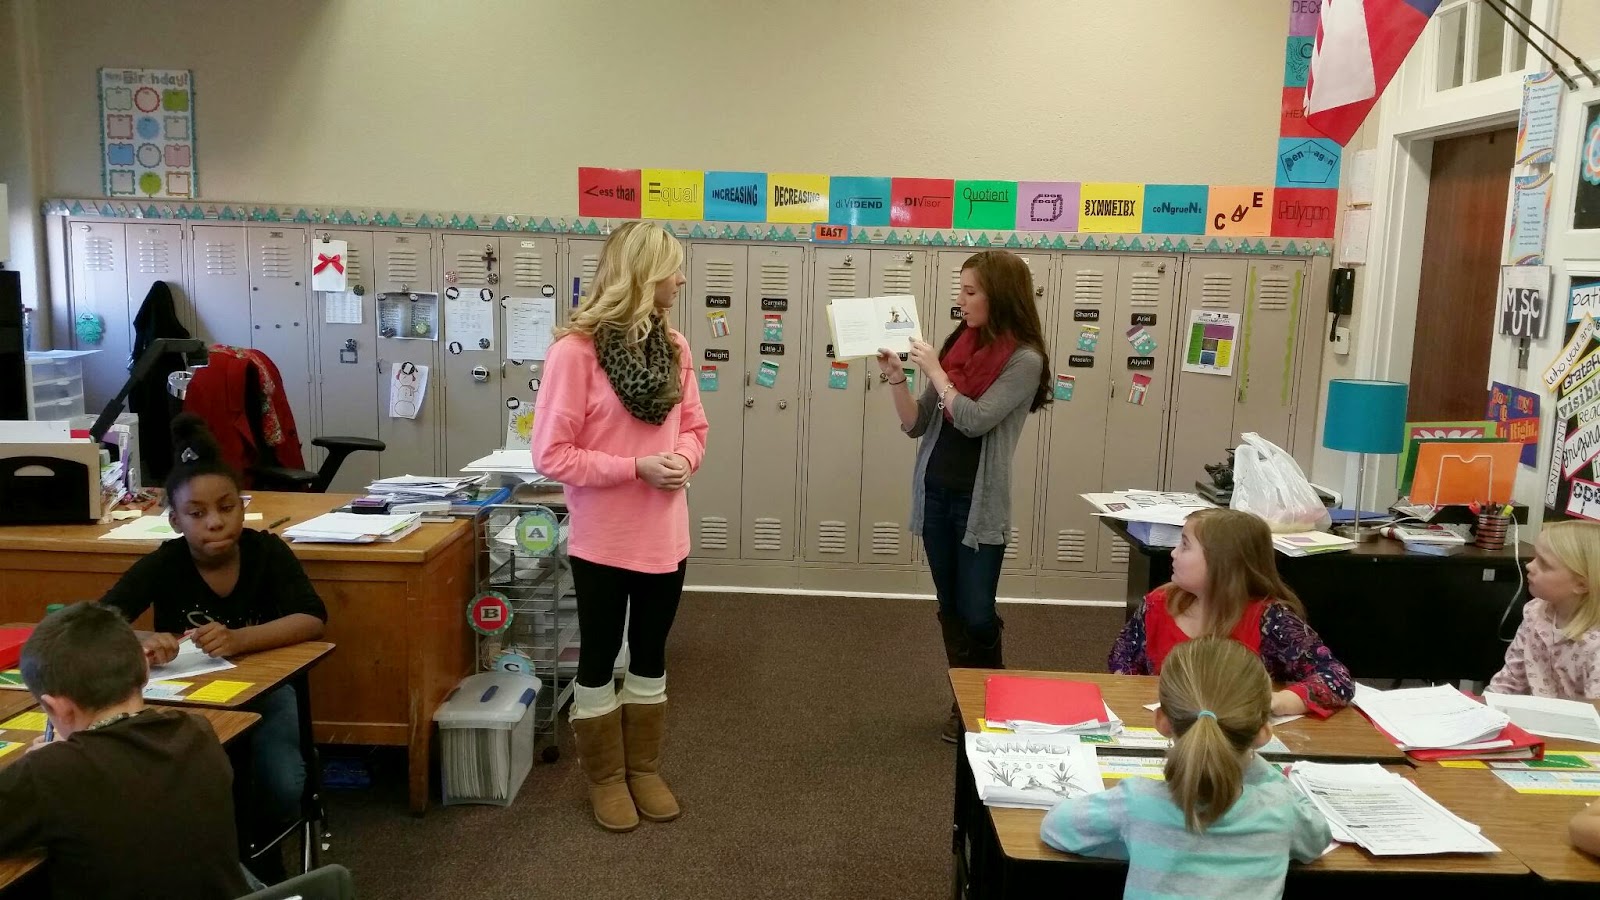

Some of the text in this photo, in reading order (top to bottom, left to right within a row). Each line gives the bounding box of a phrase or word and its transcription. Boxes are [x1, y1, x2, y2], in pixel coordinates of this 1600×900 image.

[616, 185, 635, 201] than
[649, 182, 698, 206] Equal
[712, 184, 758, 206] INCREASING
[774, 185, 820, 207] DECREASING
[963, 187, 1009, 206] Quotient
[1085, 199, 1136, 217] SYMMETRY
[1279, 201, 1330, 228] Polygon
[820, 227, 843, 238] EAST
[527, 527, 545, 538] A
[482, 608, 499, 619] B
[503, 663, 520, 672] C
